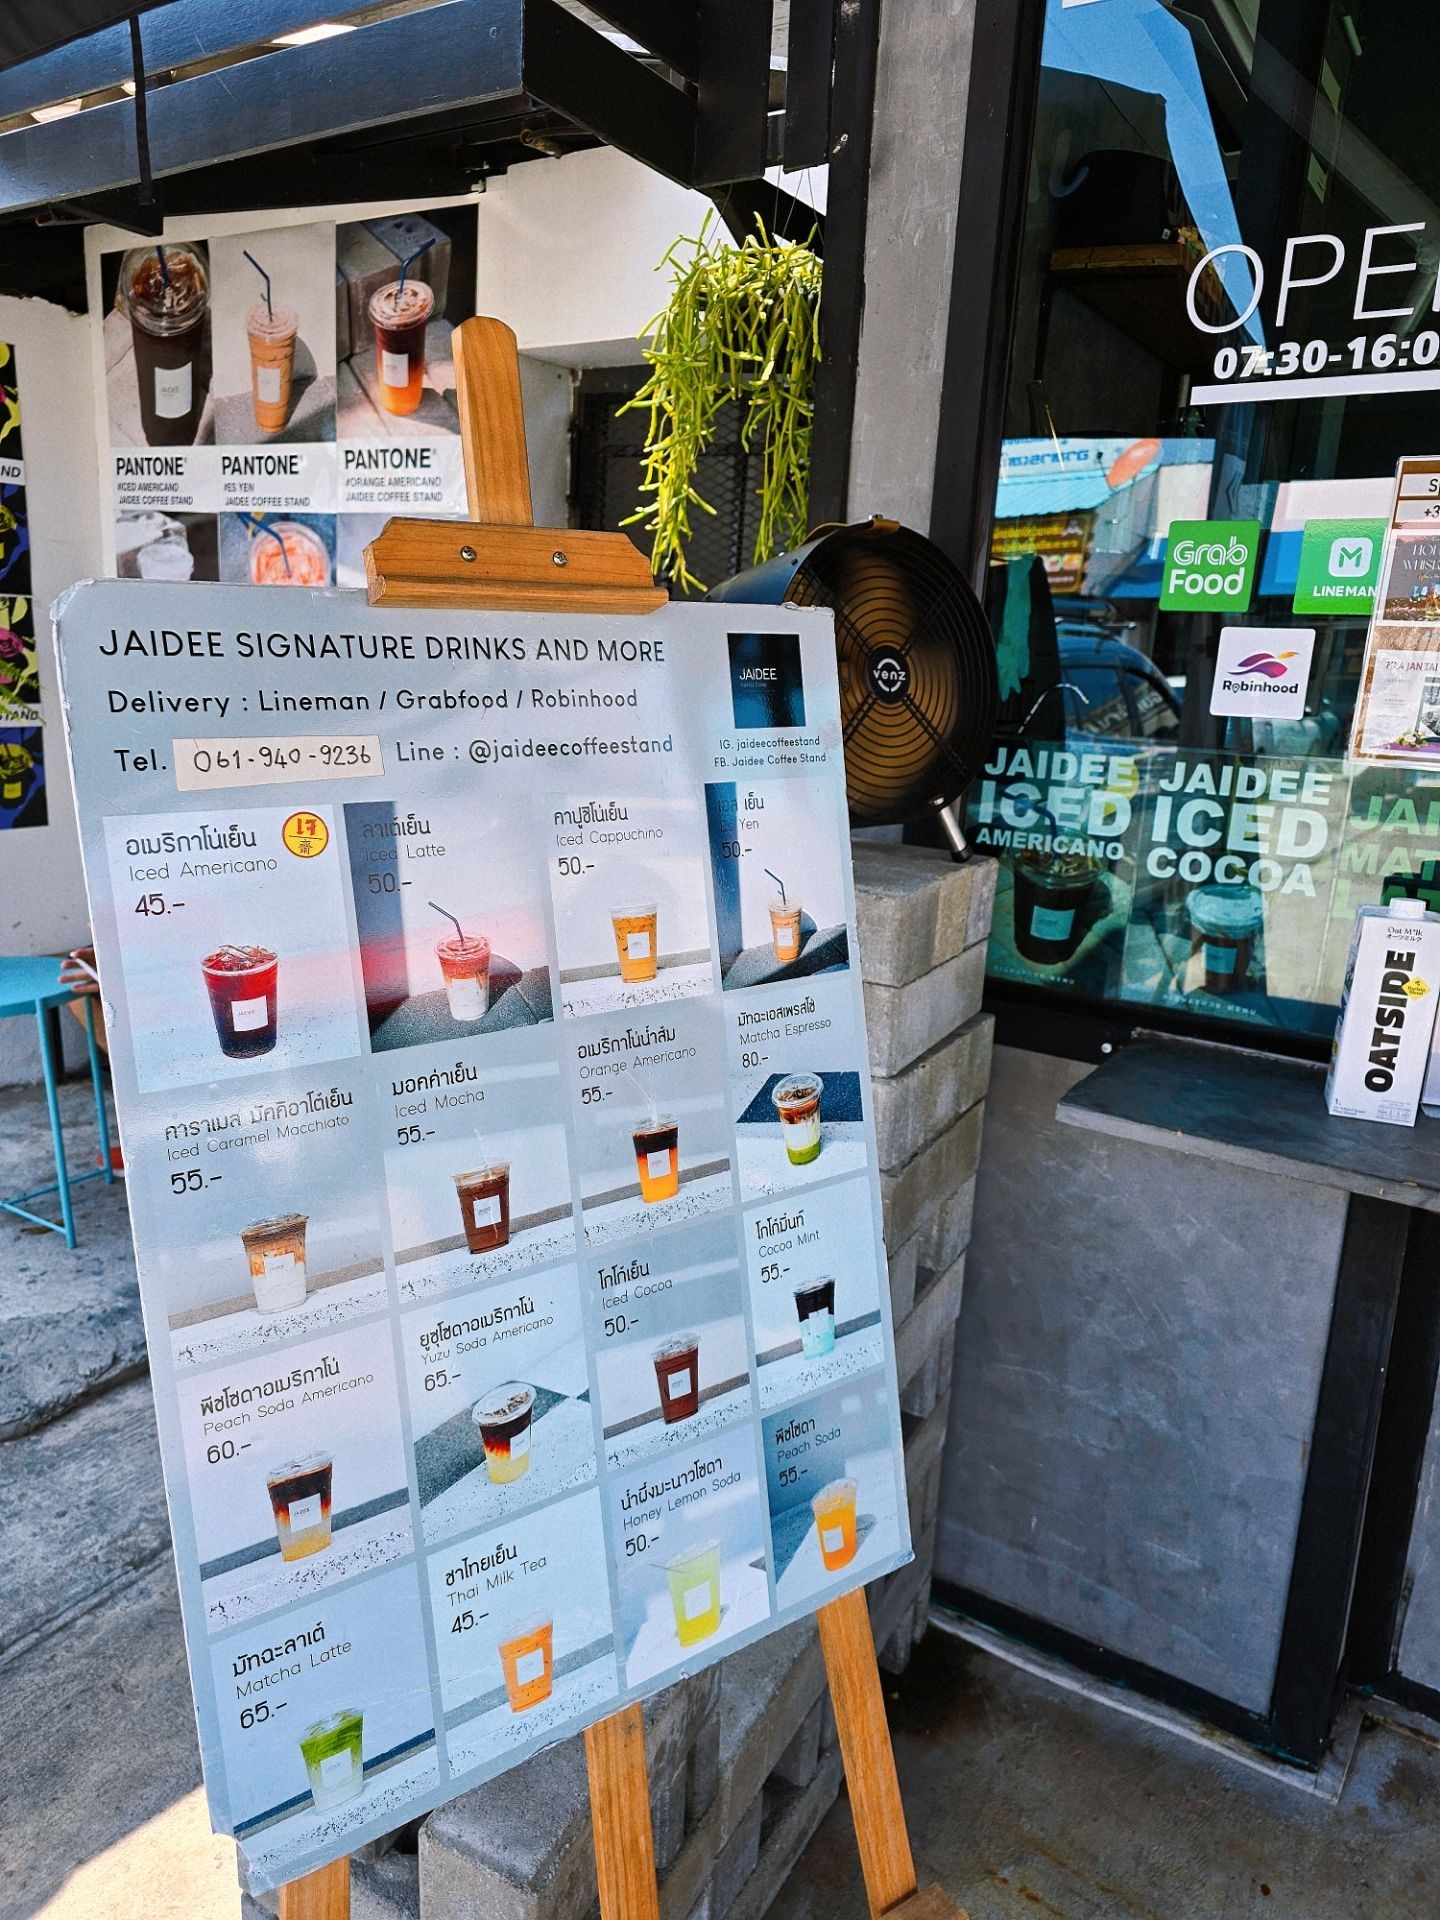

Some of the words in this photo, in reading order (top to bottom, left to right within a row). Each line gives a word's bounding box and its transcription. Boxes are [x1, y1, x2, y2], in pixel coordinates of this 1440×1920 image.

[1187, 221, 1440, 333] OPE
[116, 457, 184, 476] PANTONE
[222, 455, 299, 475] PANTONE
[342, 448, 431, 470] PANTONE
[378, 492, 410, 502] COFFEE
[412, 492, 443, 502] STAND
[1173, 536, 1248, 566] Grab
[1168, 567, 1245, 595] Food
[100, 630, 225, 658] JAIDEE
[236, 632, 416, 660] SIGNATURE
[426, 636, 527, 661] DRINKS
[536, 639, 589, 662] AND
[597, 640, 666, 662] MORE
[739, 668, 777, 680] JAIDEE
[873, 669, 906, 680] venz
[1222, 679, 1298, 694] Robinhood
[108, 690, 231, 718] Delivery
[258, 690, 370, 712] Lineman
[396, 689, 508, 711] Grabfood
[531, 688, 638, 708] Robinhood
[114, 749, 167, 772] Tel.
[193, 745, 372, 773] 061-940-9236
[396, 742, 445, 762] Line
[469, 734, 674, 764] @jaideecoffeestand
[719, 740, 734, 750] IG.
[736, 736, 821, 752] jaideecoffeestand
[714, 757, 730, 768] FB.
[732, 755, 765, 767] Jaidee
[767, 754, 798, 765] Coffee
[800, 752, 827, 763] Stand
[984, 747, 1136, 788] JAIDEE
[1159, 761, 1334, 806] JAIDEE
[744, 791, 765, 810] เย็น
[978, 779, 1133, 838] ICED
[362, 814, 431, 838] ลาเต้เย็น
[556, 832, 584, 848] Iced
[589, 827, 664, 846] Cappuchino
[739, 818, 760, 830] Yen
[1151, 795, 1330, 859] ICED
[126, 824, 257, 856] อเมริกาโน่เย็น
[365, 847, 399, 862] Iced
[406, 844, 446, 859] Latte
[722, 841, 752, 859] 50.-
[975, 827, 1125, 861] AMERICANO
[129, 863, 170, 881] Iced
[179, 857, 278, 878] Americano
[558, 856, 595, 876] 50.-
[1146, 846, 1317, 898] COCOA
[368, 872, 412, 894] 50.-
[134, 893, 185, 917] 45.-
[1387, 926, 1402, 934] Oat
[740, 1029, 780, 1045] Matcha
[785, 1018, 832, 1036] Espresso
[1364, 950, 1416, 1092] OATSIDE
[580, 1061, 627, 1079] Orange
[633, 1046, 697, 1069] Americano
[742, 1051, 769, 1068] 80.-
[392, 1062, 478, 1096] มอคค่าเย็น
[395, 1099, 427, 1118] Iced
[435, 1090, 485, 1110] Mocha
[581, 1086, 613, 1105] 55.-
[167, 1143, 200, 1161] Iced
[207, 1129, 270, 1153] Caramel
[277, 1114, 350, 1138] Macchiato
[397, 1125, 436, 1145] 55.-
[171, 1168, 223, 1194] 55.-
[759, 1240, 793, 1258] Cocoa
[797, 1230, 820, 1246] Mint
[598, 1259, 650, 1290] โกโก้เย็น
[761, 1263, 790, 1283] 55.-
[602, 1289, 629, 1310] Iced
[634, 1279, 673, 1299] Cocoa
[604, 1315, 639, 1337] 50.-
[421, 1348, 450, 1365] Yuzu
[456, 1337, 487, 1354] Soda
[492, 1315, 554, 1343] Americano
[424, 1369, 461, 1391] 65.-
[203, 1412, 251, 1436] Peach
[257, 1398, 295, 1418] Soda
[301, 1373, 374, 1405] Americano
[775, 1418, 816, 1445] พีชโซดา
[207, 1440, 252, 1464] 60.-
[777, 1441, 811, 1464] Peach
[815, 1427, 841, 1447] Soda
[779, 1465, 808, 1487] 55.-
[622, 1506, 662, 1531] Honey
[667, 1487, 707, 1512] Lemon
[712, 1471, 741, 1492] Soda
[625, 1533, 660, 1557] 50.-
[444, 1543, 517, 1587] ชาไทยเย็น
[446, 1583, 479, 1607] Thai
[486, 1569, 514, 1591] Milk
[519, 1556, 547, 1575] Tea
[451, 1609, 489, 1634] 45.-
[232, 1621, 325, 1677] มัทฉะลาเต้
[236, 1662, 302, 1700] Matcha
[309, 1641, 352, 1668] Latte
[239, 1700, 287, 1729] 65.-
